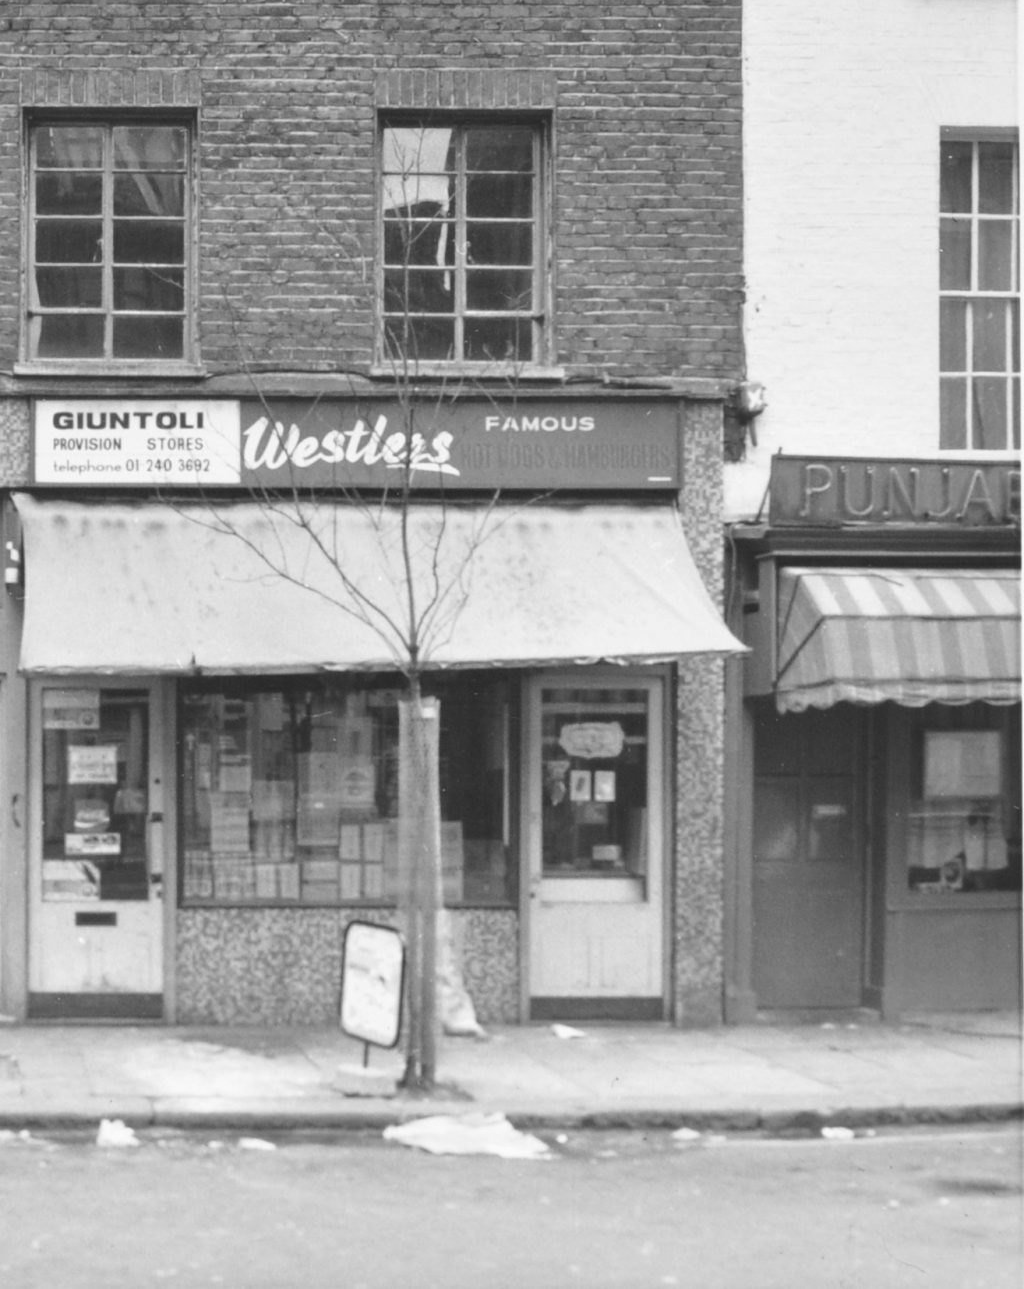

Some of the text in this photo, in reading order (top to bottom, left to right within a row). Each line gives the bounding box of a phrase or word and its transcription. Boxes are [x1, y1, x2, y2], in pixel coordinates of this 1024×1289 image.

[53, 413, 204, 429] GIUNTOLI
[485, 416, 595, 432] FAMOUS
[53, 437, 204, 451] PROVISION STORES
[243, 414, 454, 471] Westlers
[566, 443, 673, 469] HAMBURGERS
[53, 459, 121, 474] telephone
[125, 459, 140, 472] 01
[146, 459, 173, 472] 240
